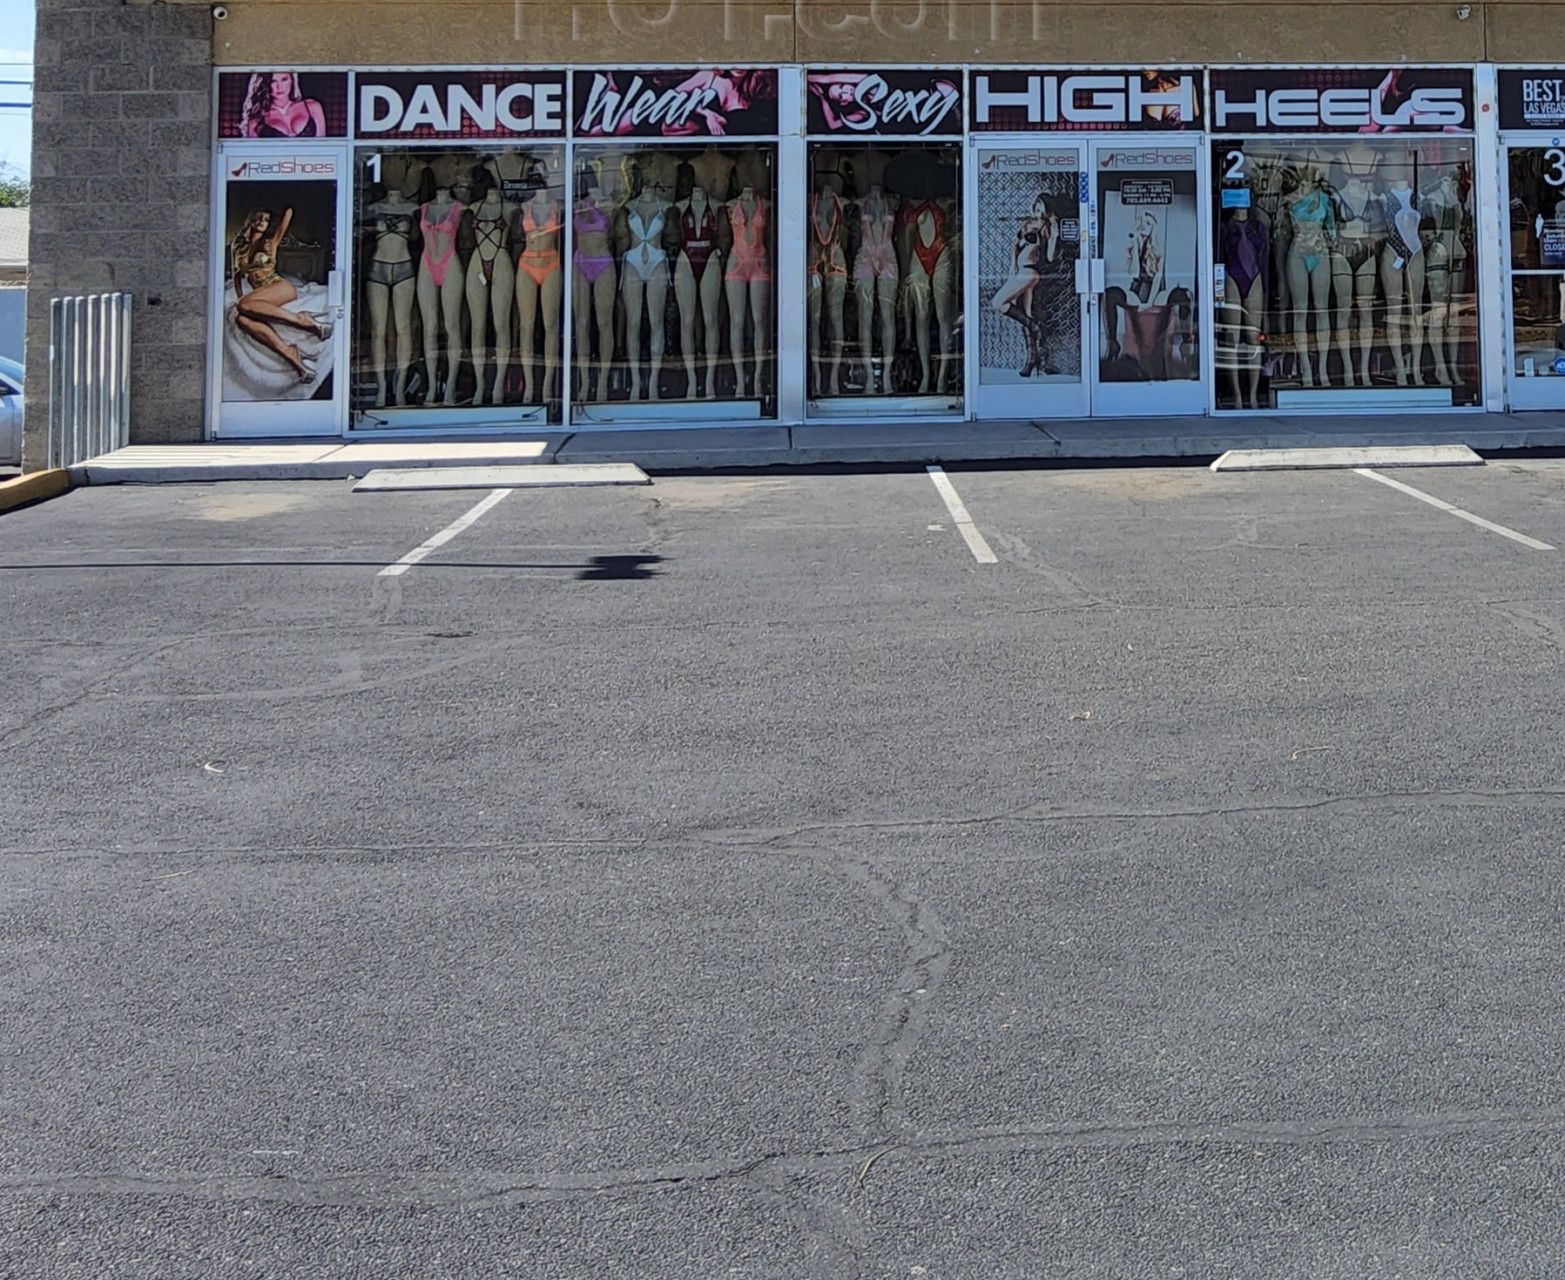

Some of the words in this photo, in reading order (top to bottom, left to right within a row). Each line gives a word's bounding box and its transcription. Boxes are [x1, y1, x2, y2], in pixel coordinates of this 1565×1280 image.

[1523, 80, 1563, 101] BEST
[360, 83, 562, 133] DANCE
[581, 73, 717, 132] Wear
[841, 73, 961, 136] Sexy
[976, 76, 1194, 122] HIGH
[1215, 87, 1466, 127] HEELS
[1524, 103, 1539, 113] LAS
[1540, 103, 1565, 114] VEGAS
[248, 158, 335, 177] RedShoes
[366, 154, 382, 183] 1
[996, 149, 1076, 169] RedShoes
[1115, 148, 1193, 168] RedShoes
[1225, 151, 1245, 179] 2
[1543, 149, 1565, 186] 3
